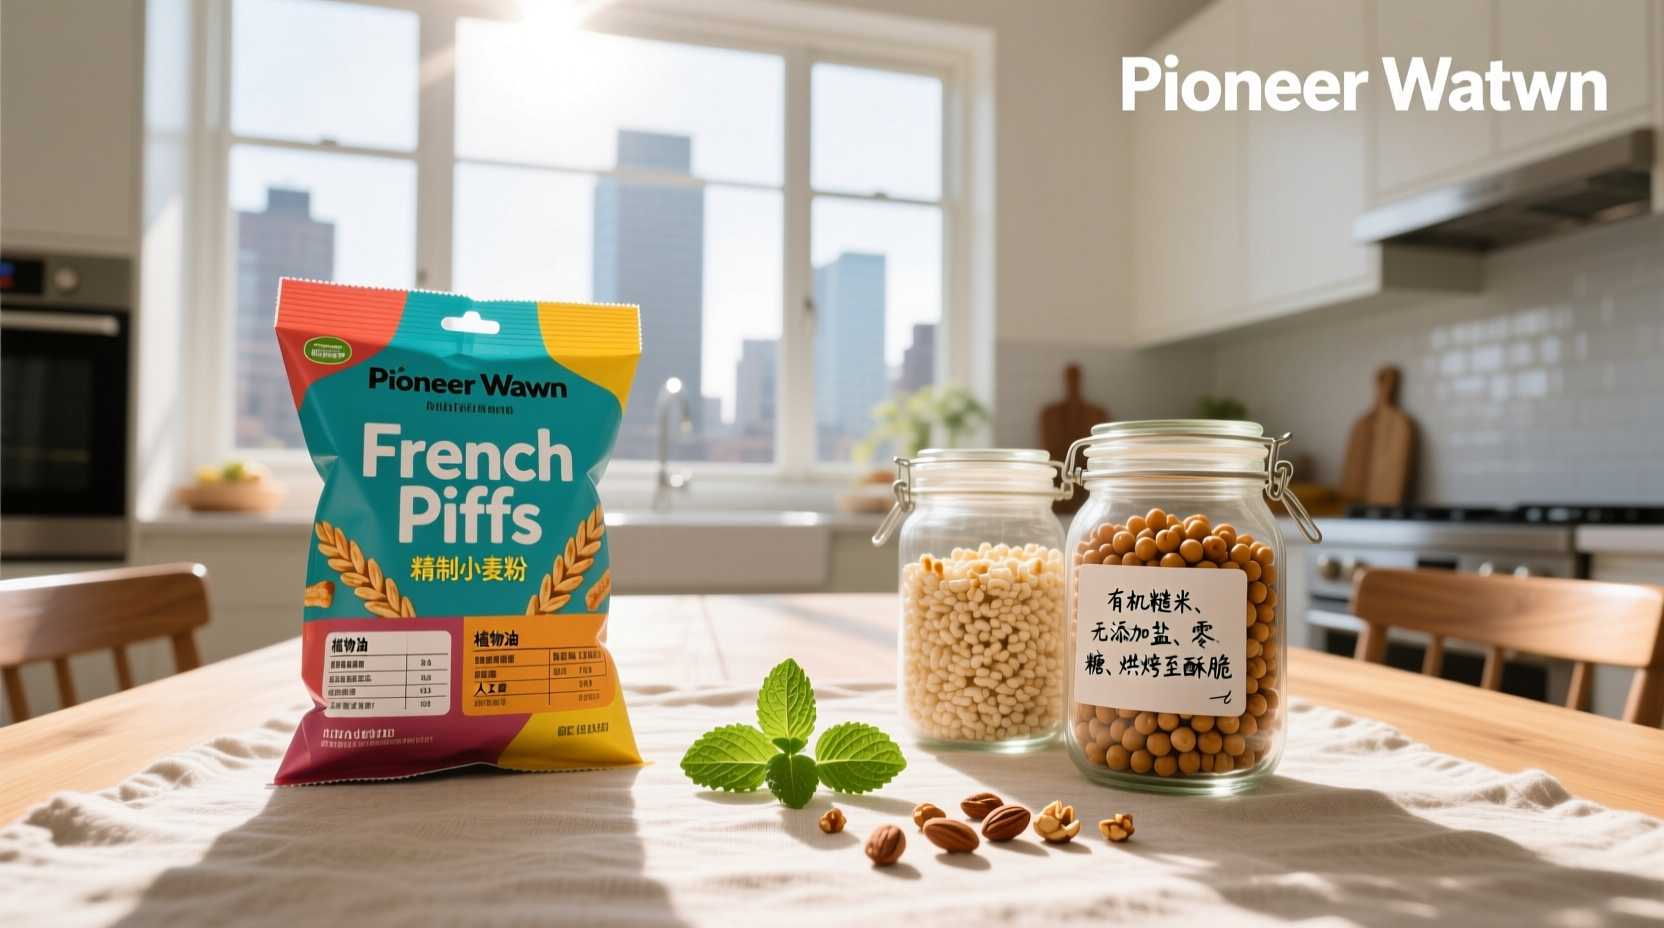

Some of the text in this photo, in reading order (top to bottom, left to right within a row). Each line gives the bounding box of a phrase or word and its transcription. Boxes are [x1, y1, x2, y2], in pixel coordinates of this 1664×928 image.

[368, 365, 568, 399] Pioneer Wawn
[362, 422, 574, 482] French
[399, 485, 543, 545] Piffs
[410, 554, 528, 582] 精制小麦粉
[473, 630, 519, 648] 植物油
